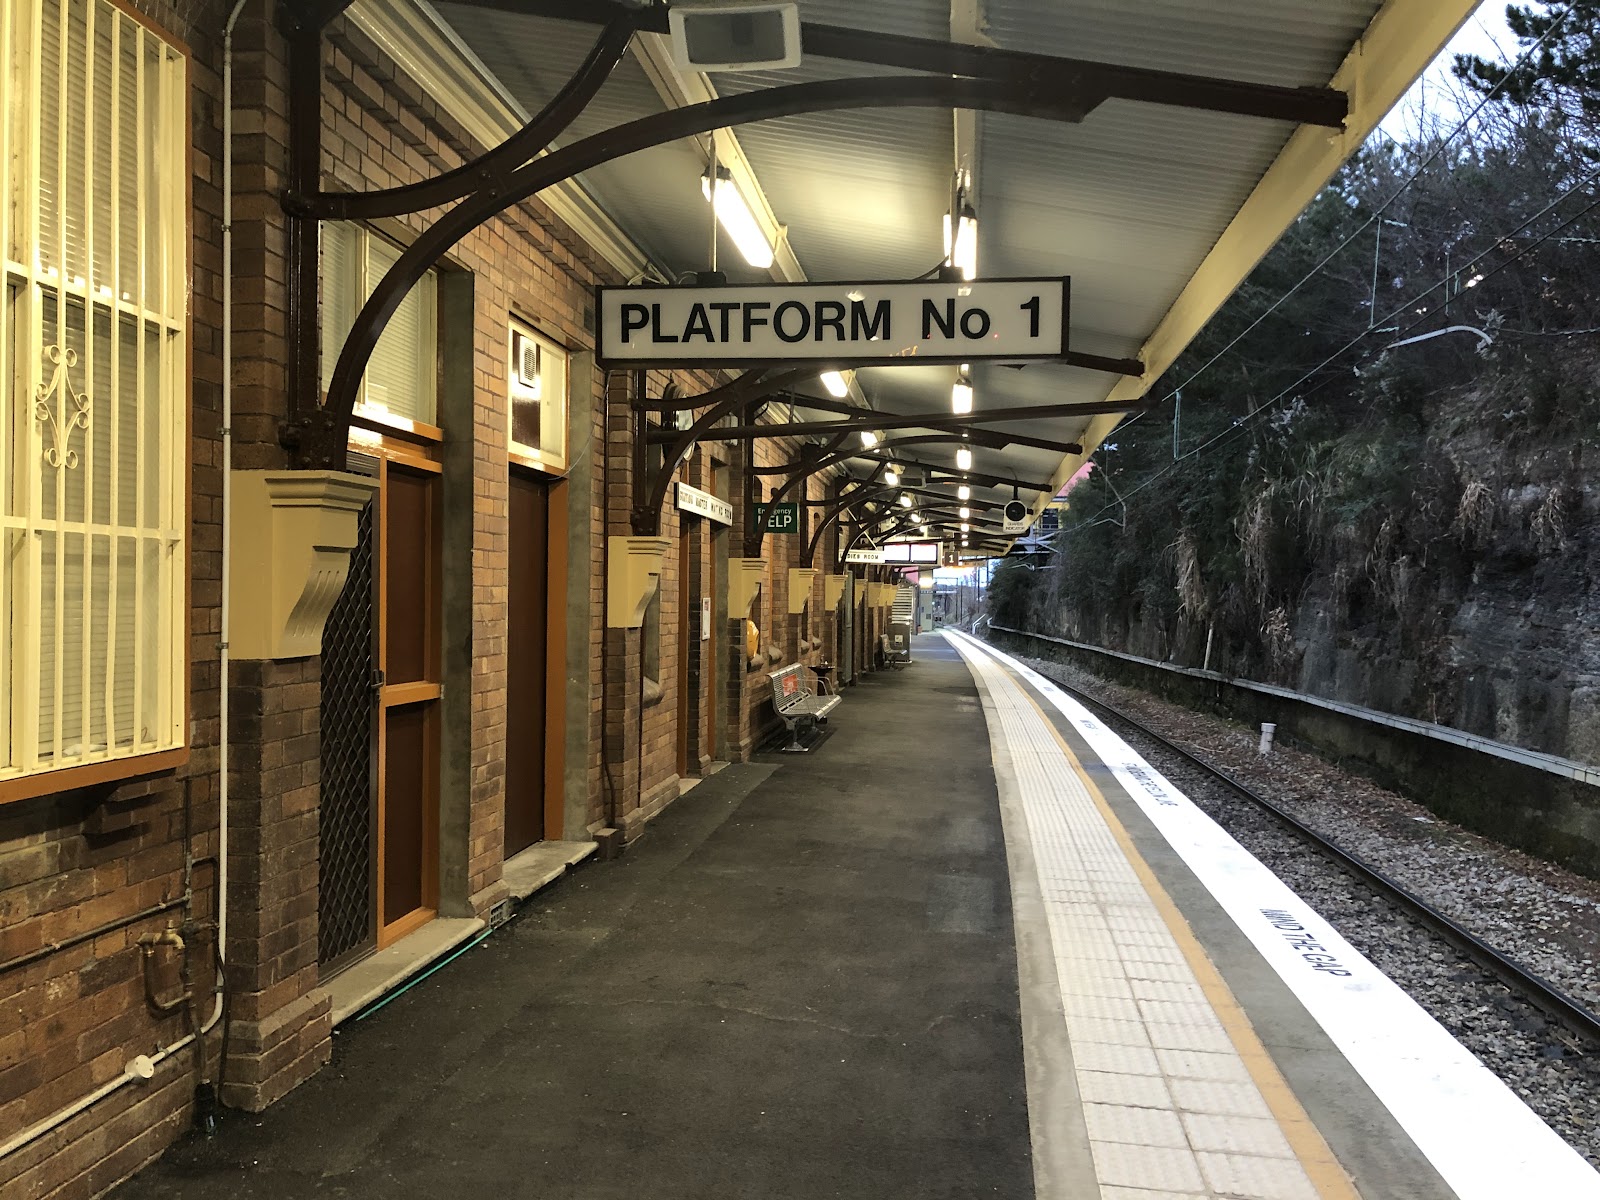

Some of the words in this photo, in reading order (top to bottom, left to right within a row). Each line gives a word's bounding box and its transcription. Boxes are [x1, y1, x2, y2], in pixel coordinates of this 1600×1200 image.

[620, 298, 891, 344] PLATFORM
[921, 297, 992, 340] No
[1019, 295, 1041, 338] 1
[947, 554, 955, 564] 1
[1259, 908, 1305, 931] MIND
[1281, 933, 1327, 952] THE
[1301, 953, 1353, 977] GAP
